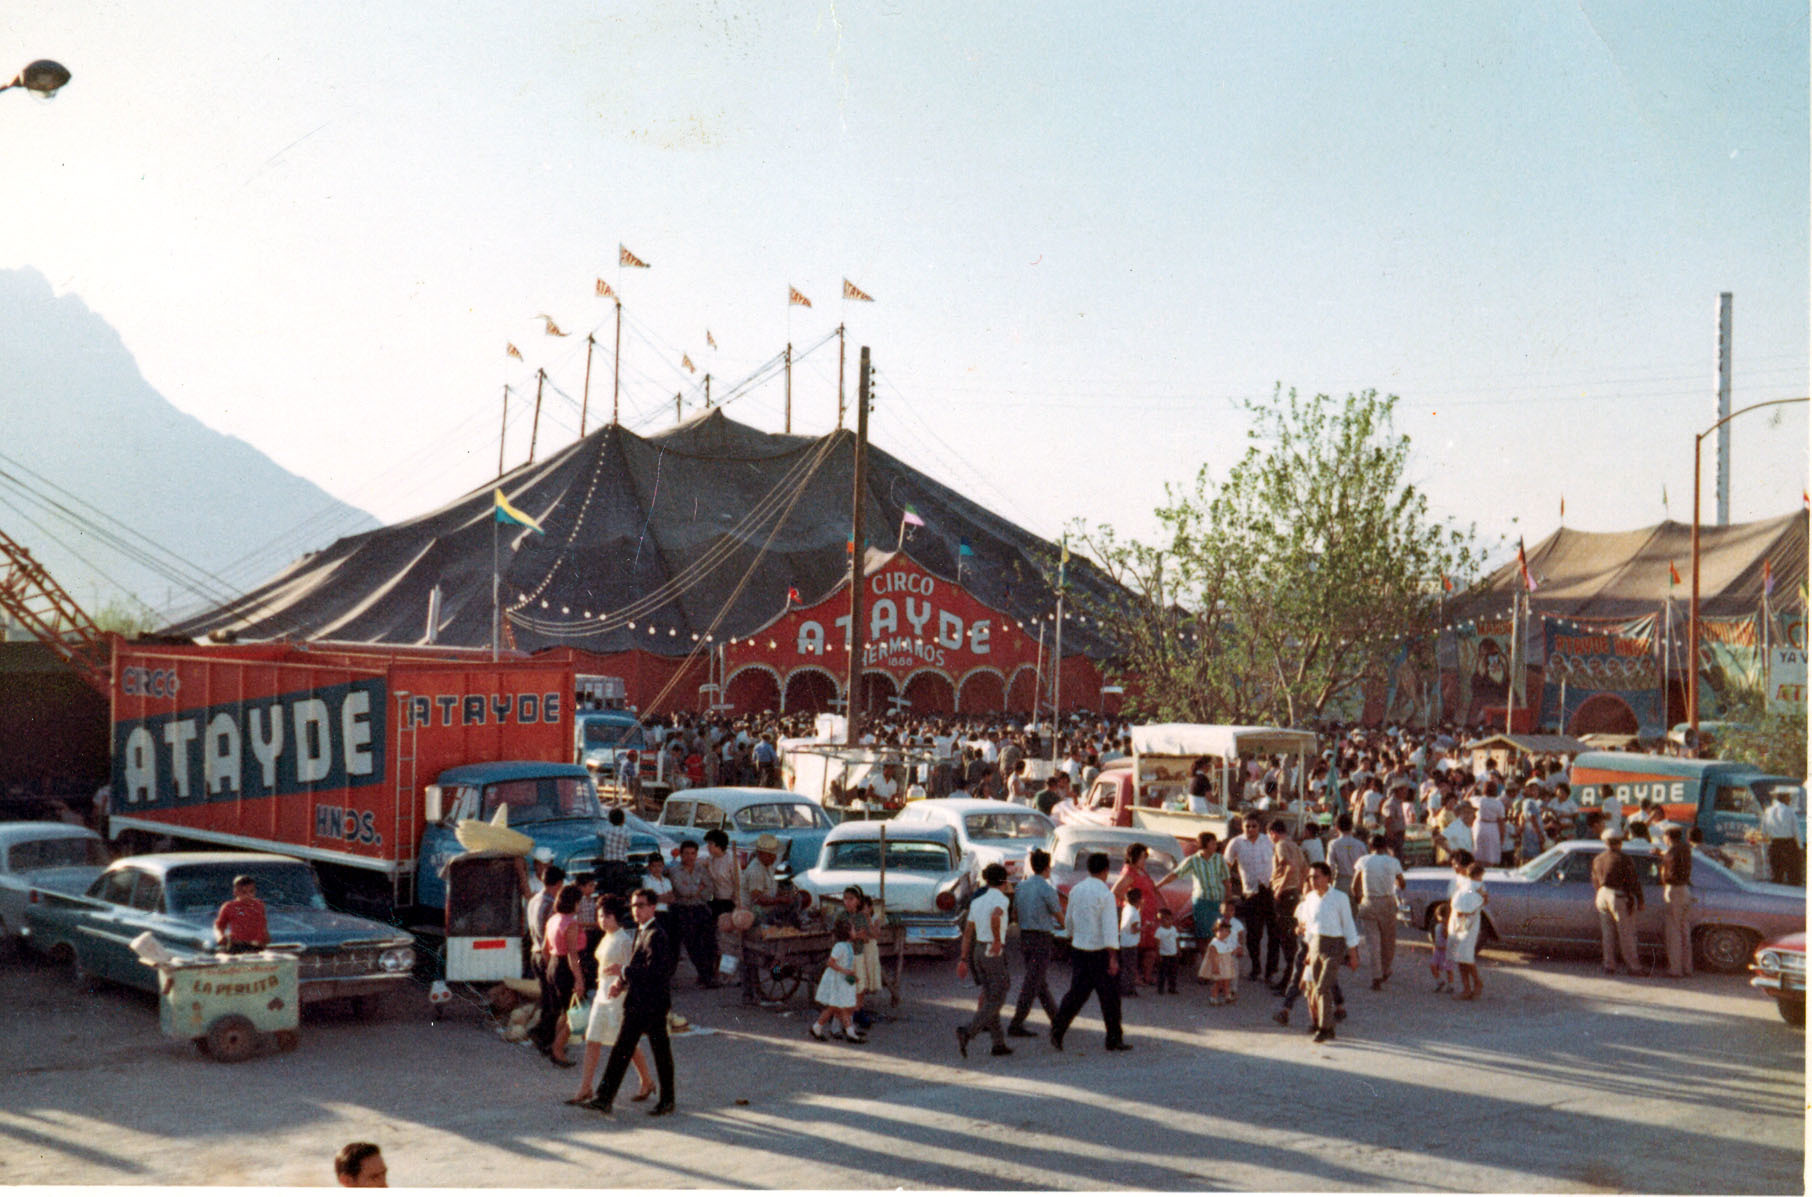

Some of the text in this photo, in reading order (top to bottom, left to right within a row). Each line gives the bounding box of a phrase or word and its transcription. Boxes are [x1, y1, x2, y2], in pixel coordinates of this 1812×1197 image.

[871, 571, 934, 596] CIRCO
[1779, 651, 1797, 664] YA
[121, 666, 180, 698] CIRCO
[407, 692, 561, 727] ATAYDE
[124, 690, 374, 803] ATAYDE
[1581, 782, 1684, 806] AAYDE
[193, 980, 213, 996] LA
